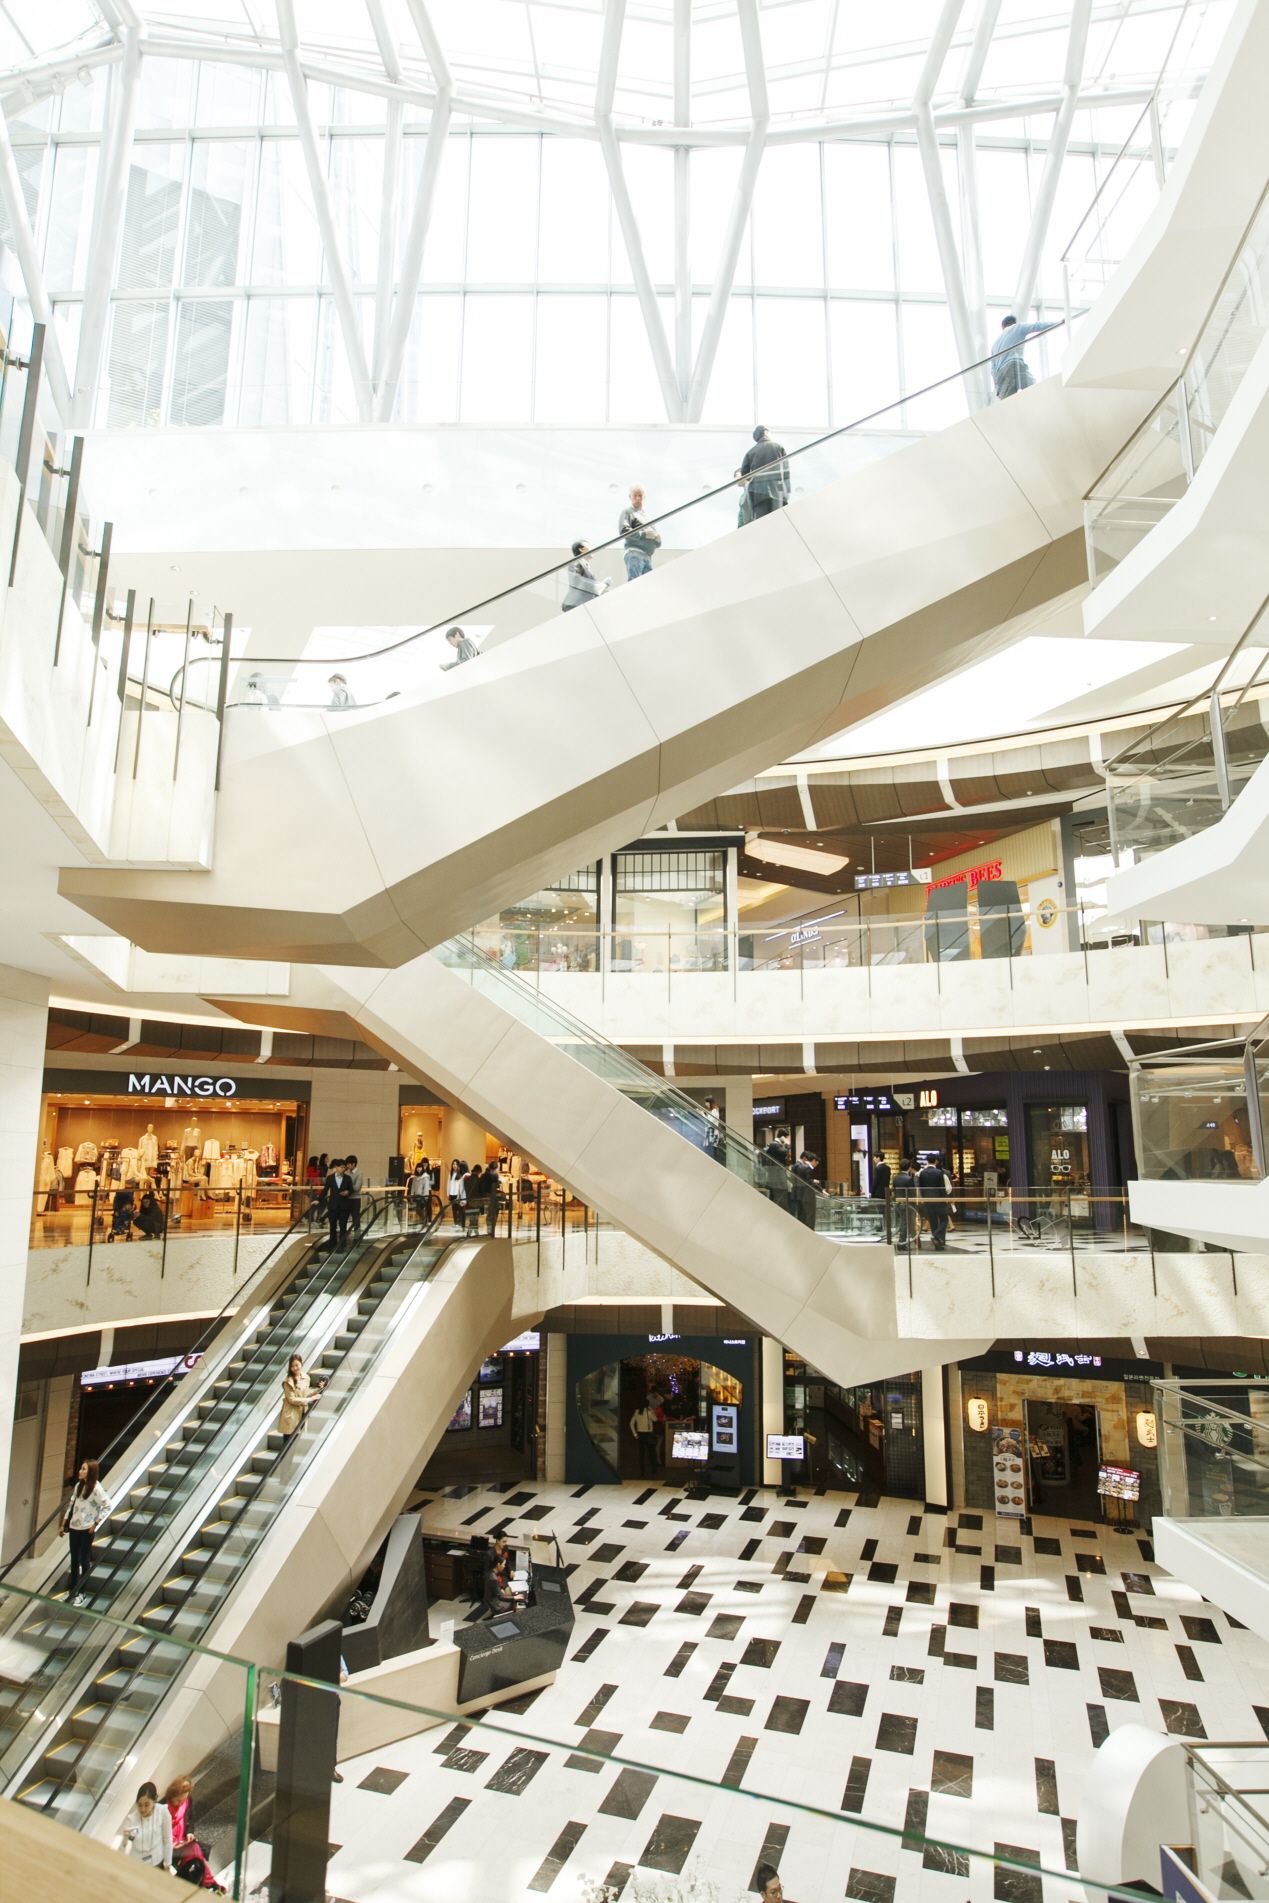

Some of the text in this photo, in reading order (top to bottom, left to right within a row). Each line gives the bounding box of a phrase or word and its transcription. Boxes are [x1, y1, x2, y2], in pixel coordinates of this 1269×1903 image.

[128, 1073, 236, 1096] MANGO
[902, 1097, 912, 1106] L2
[920, 1090, 938, 1108] ALO
[1051, 1149, 1070, 1160] ALO
